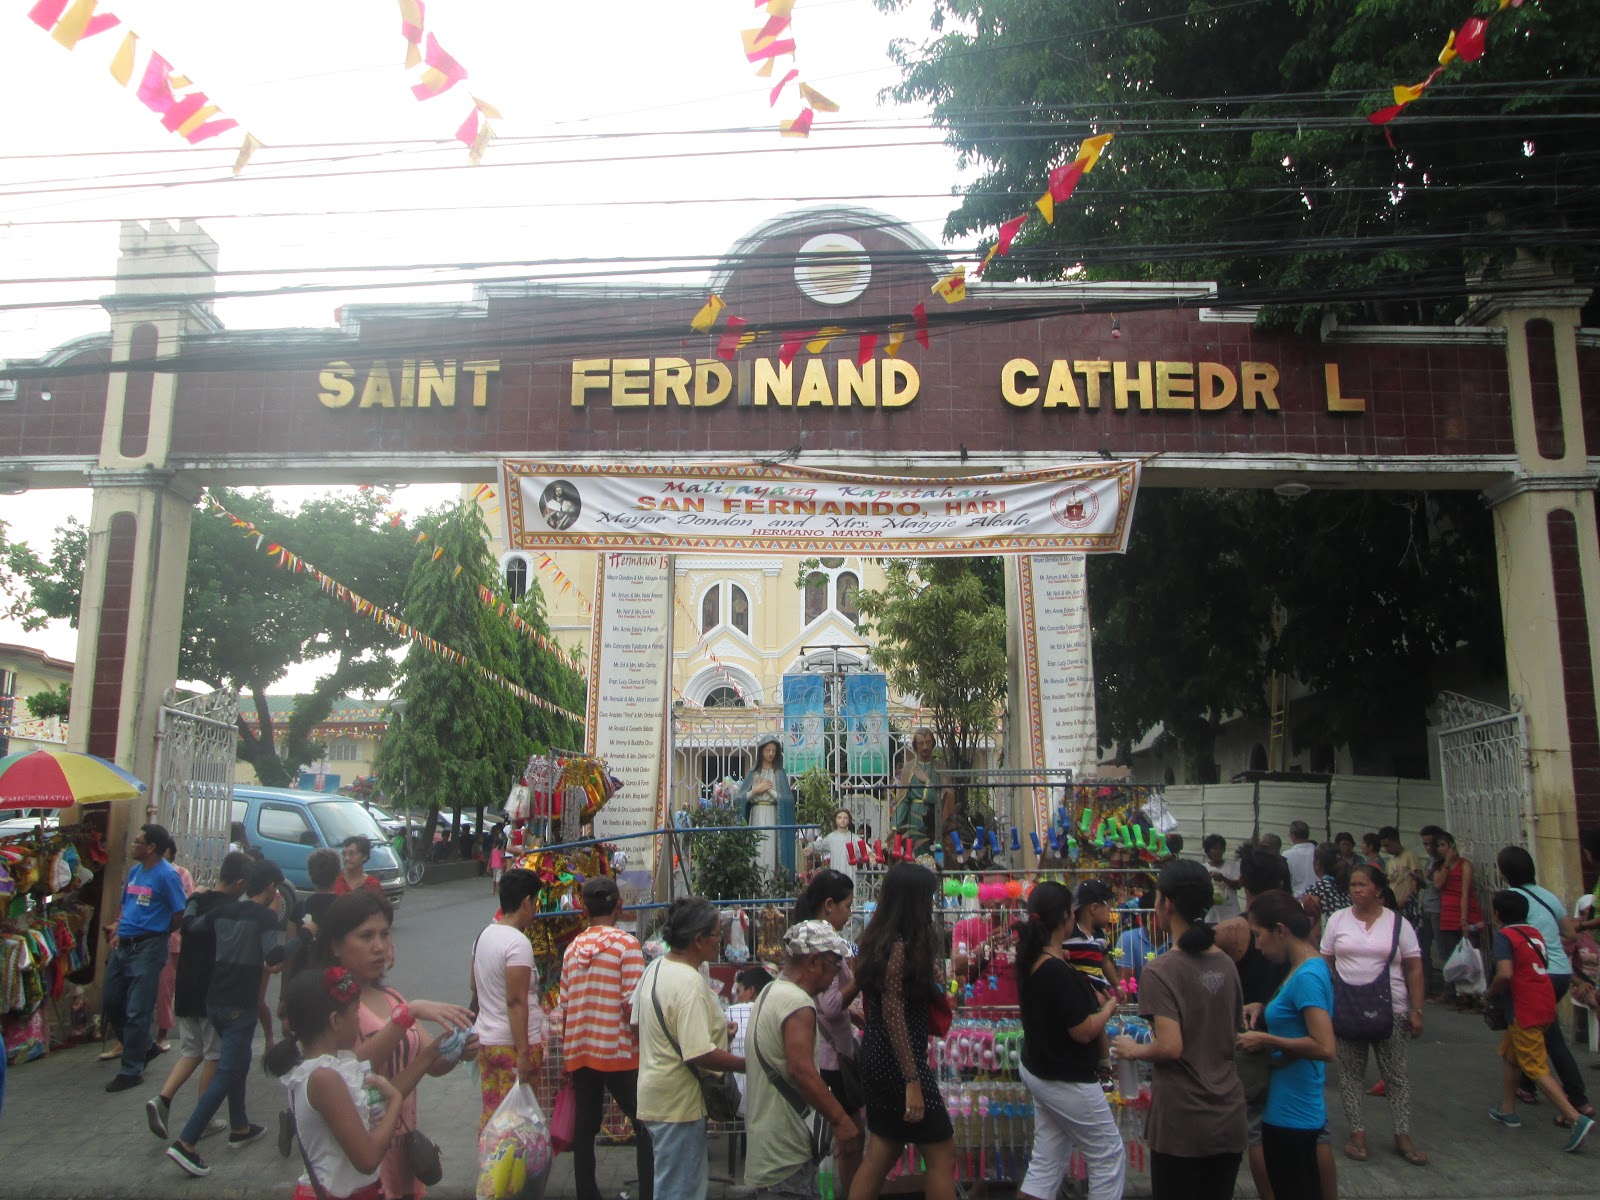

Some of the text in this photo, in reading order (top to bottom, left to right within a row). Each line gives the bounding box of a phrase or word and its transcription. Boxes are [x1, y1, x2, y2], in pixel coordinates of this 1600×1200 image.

[318, 357, 501, 409] SAINT
[571, 357, 921, 409] FERDINAND
[661, 480, 993, 503] Maligayang Kapistahan
[636, 495, 1006, 518] SAN FERNANDO, HARI
[596, 512, 1031, 534] Mayor Dondon and Mrs. Maggie Alcala
[751, 528, 824, 537] HERMANO
